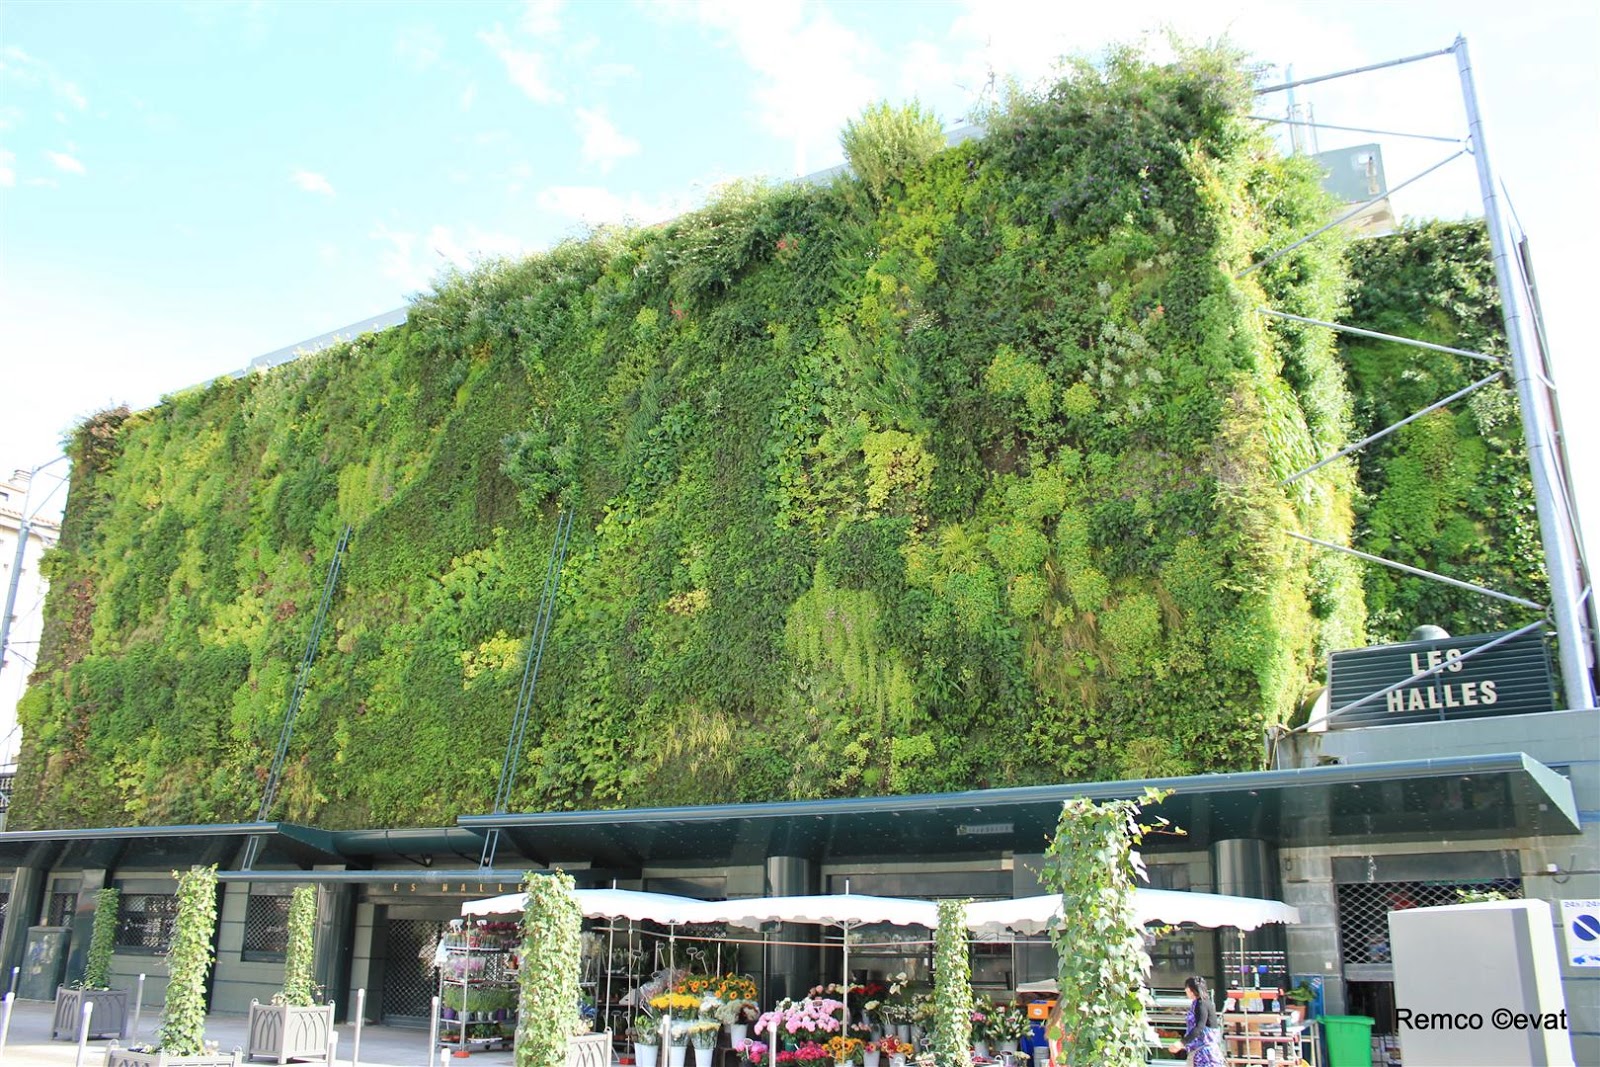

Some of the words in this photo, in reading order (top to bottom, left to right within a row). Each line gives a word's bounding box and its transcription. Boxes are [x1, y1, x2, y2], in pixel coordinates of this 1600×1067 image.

[1410, 648, 1463, 676] LES
[1387, 680, 1497, 713] HALLES
[442, 882, 523, 892] HALLE
